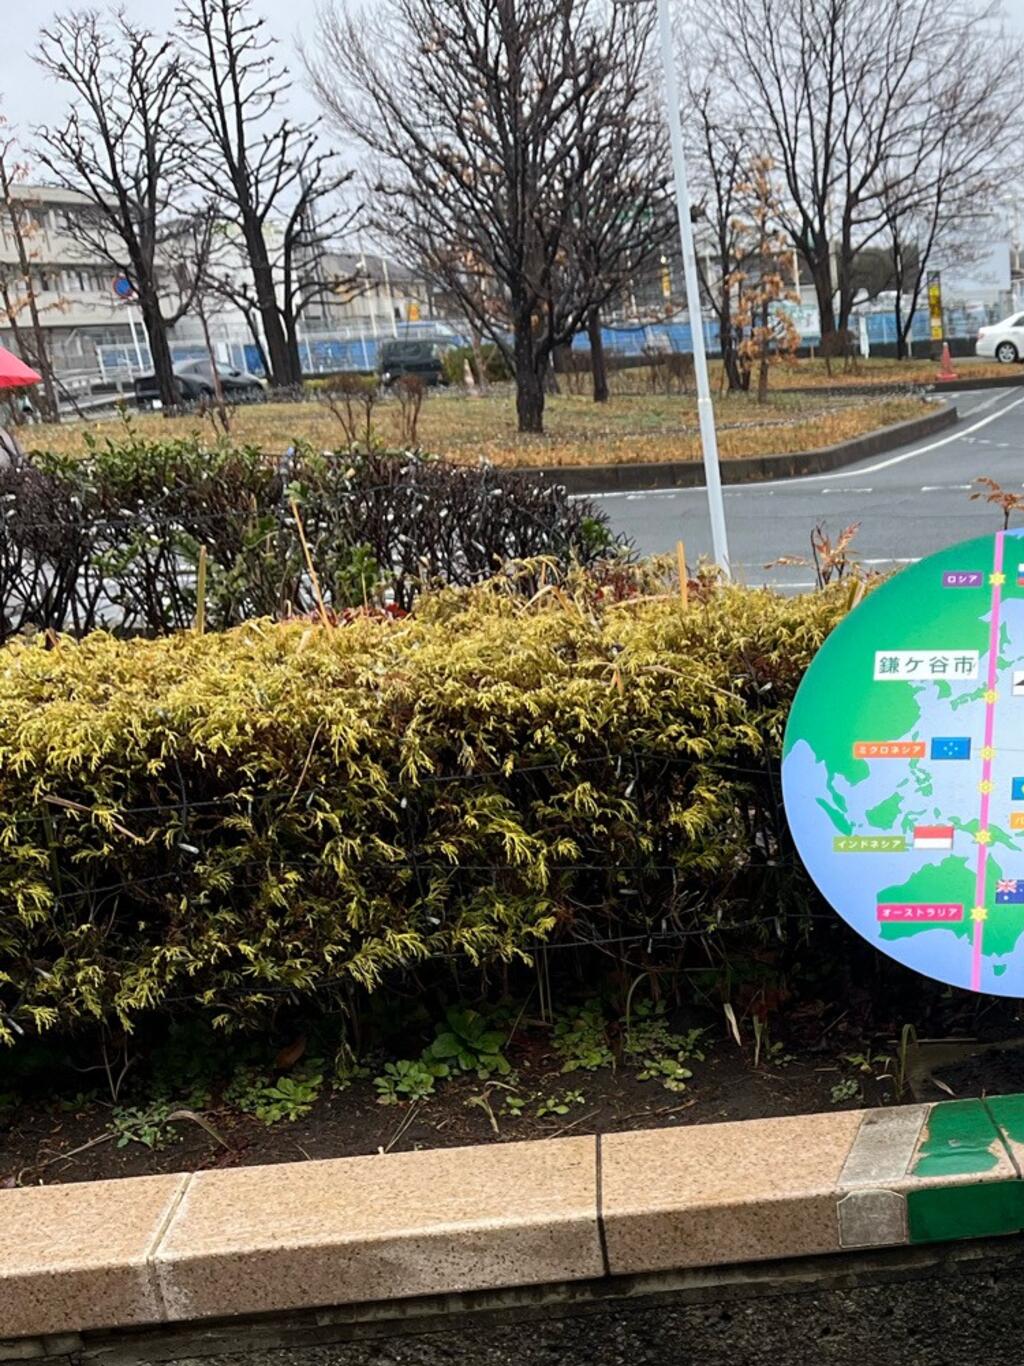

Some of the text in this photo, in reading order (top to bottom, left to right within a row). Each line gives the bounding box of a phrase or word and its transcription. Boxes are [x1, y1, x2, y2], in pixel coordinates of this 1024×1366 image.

[947, 575, 978, 583] ロシア
[879, 656, 975, 674] 鎌ケ谷市
[859, 745, 921, 754] ミクロネシア
[838, 840, 901, 848] インドネシア
[882, 908, 959, 917] オーストラリア
